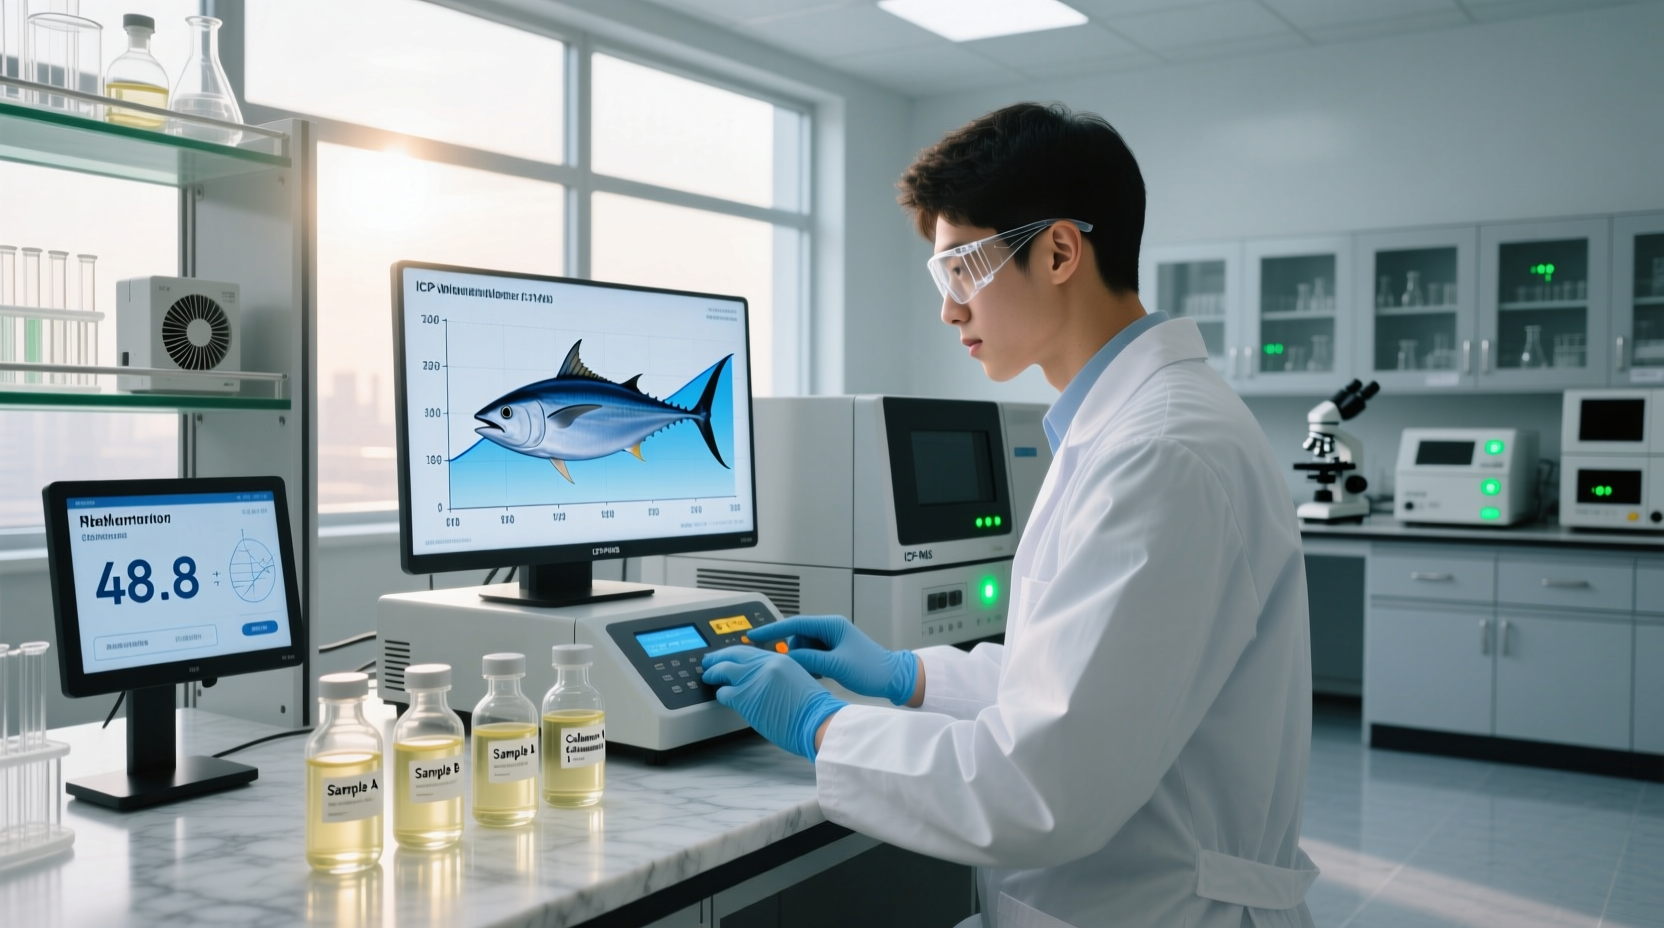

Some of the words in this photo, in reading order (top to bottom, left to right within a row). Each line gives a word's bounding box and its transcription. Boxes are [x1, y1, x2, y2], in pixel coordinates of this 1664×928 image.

[416, 280, 436, 292] ICP
[96, 556, 200, 605] 48.8
[493, 745, 529, 761] Sample
[415, 764, 451, 780] Sample
[327, 780, 368, 798] Sample
[370, 778, 379, 791] A
